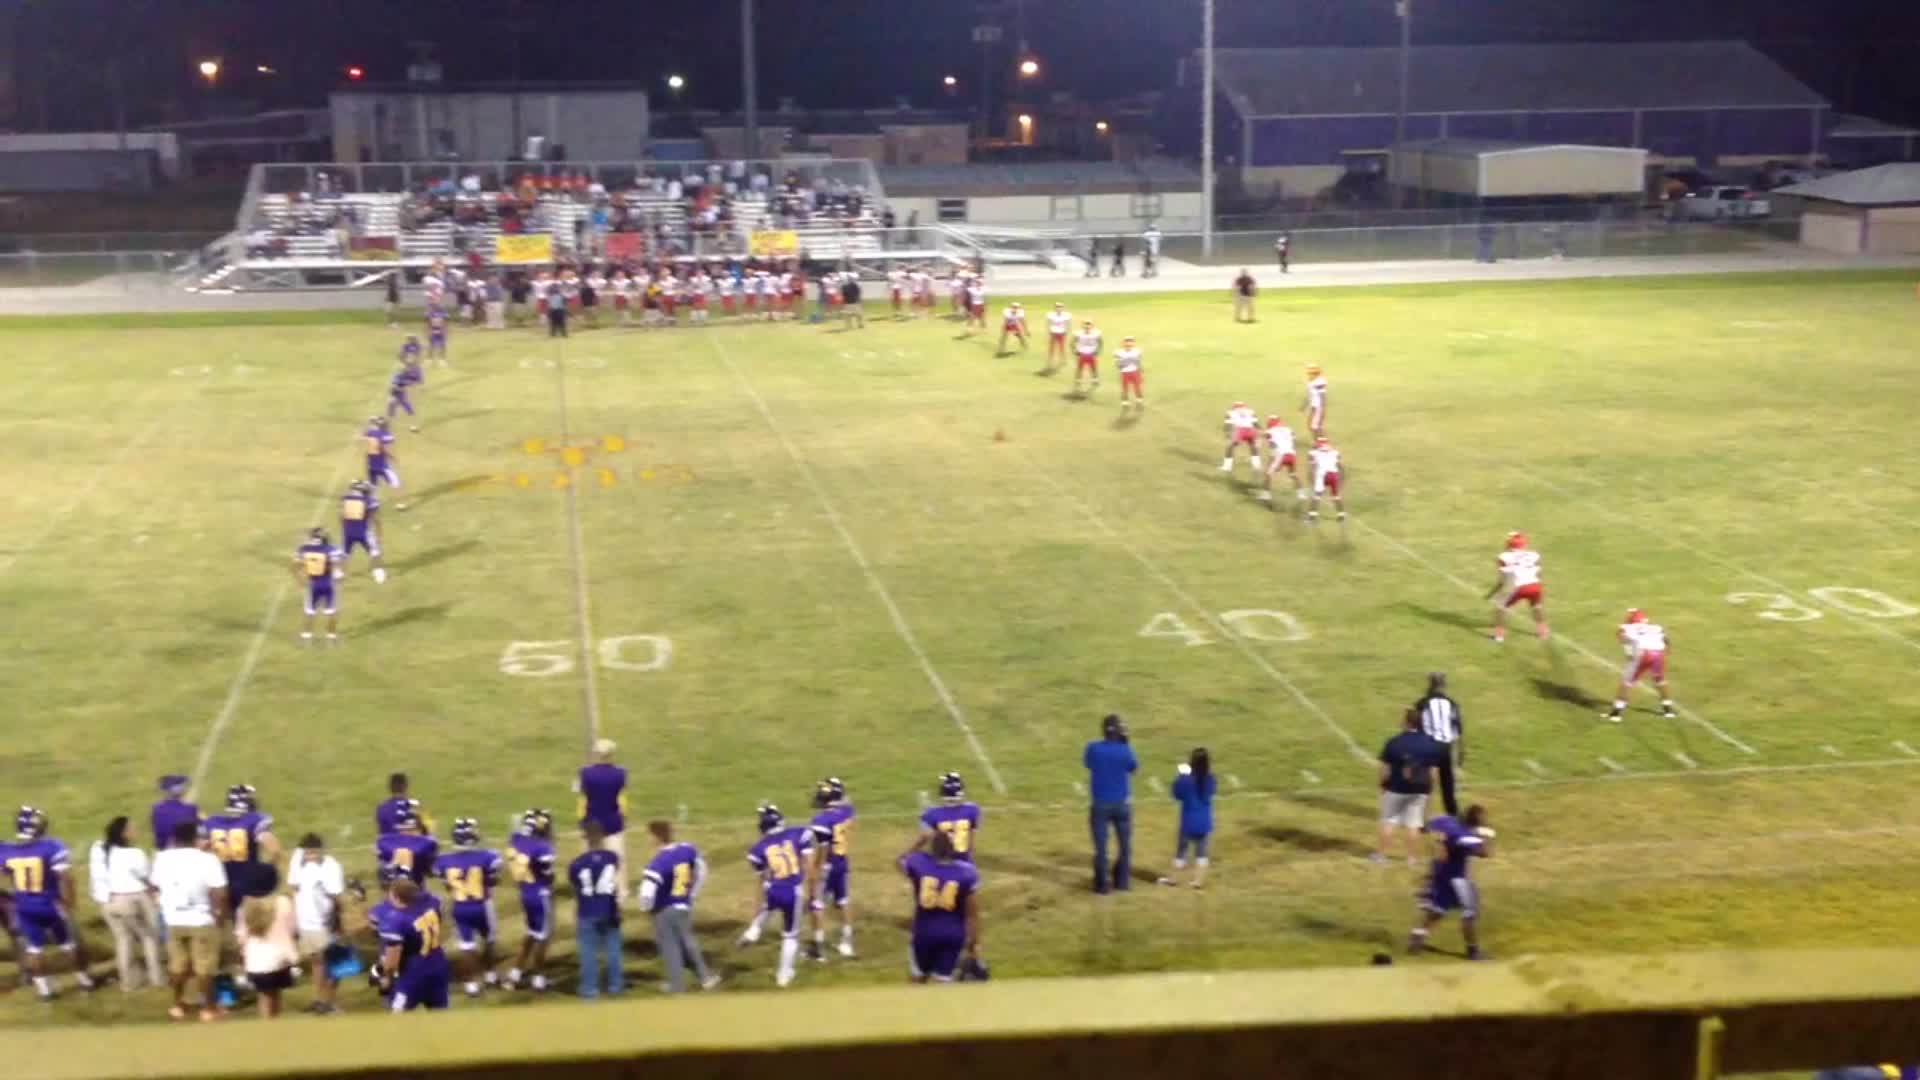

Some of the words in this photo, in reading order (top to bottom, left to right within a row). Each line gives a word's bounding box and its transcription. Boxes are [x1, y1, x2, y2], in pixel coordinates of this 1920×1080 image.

[1725, 586, 1920, 624] 30
[1136, 608, 1313, 647] 40
[499, 633, 673, 678] 50
[577, 864, 617, 897] 14
